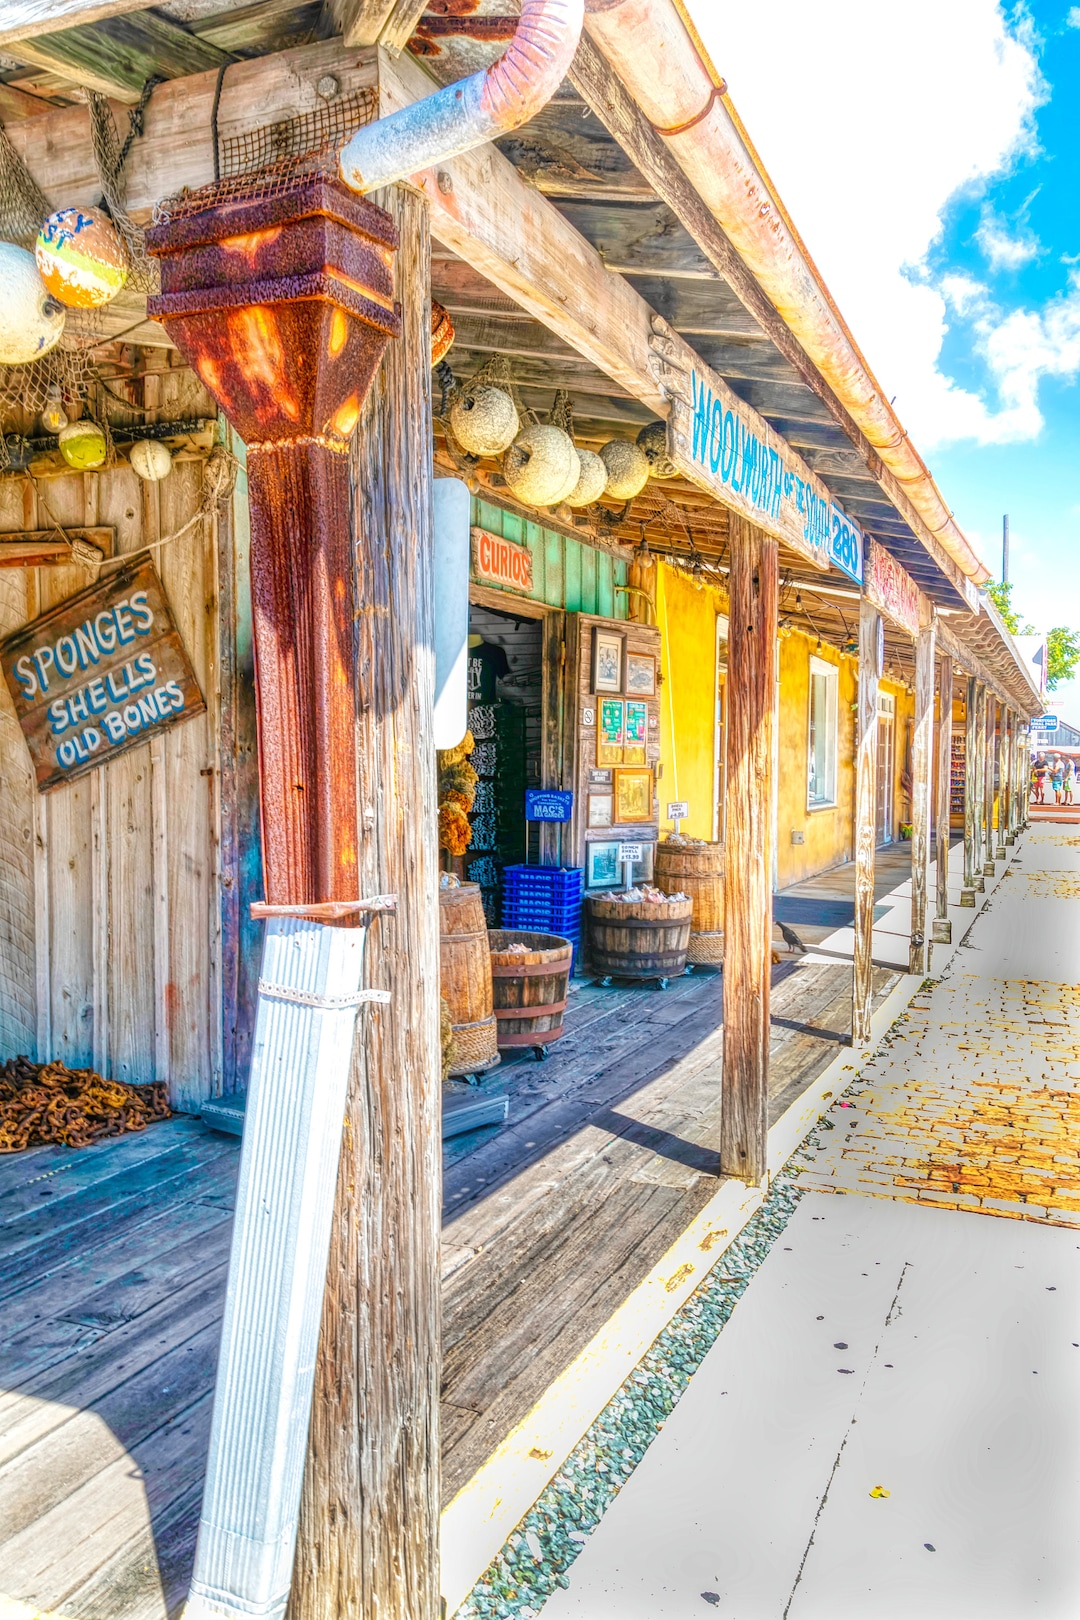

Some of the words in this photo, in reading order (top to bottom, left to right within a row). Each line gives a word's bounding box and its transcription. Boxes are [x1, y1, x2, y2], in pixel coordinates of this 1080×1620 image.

[691, 368, 783, 520] WOOLWORTH
[784, 472, 795, 498] OF
[803, 483, 831, 554] SOUTH
[478, 535, 529, 588] CURIOS
[832, 513, 858, 574] 280
[13, 590, 154, 700] SPONGES
[48, 652, 157, 734] SHELLS
[56, 727, 101, 768] OLD
[101, 679, 185, 745] BONES
[534, 805, 564, 813] MAC'S
